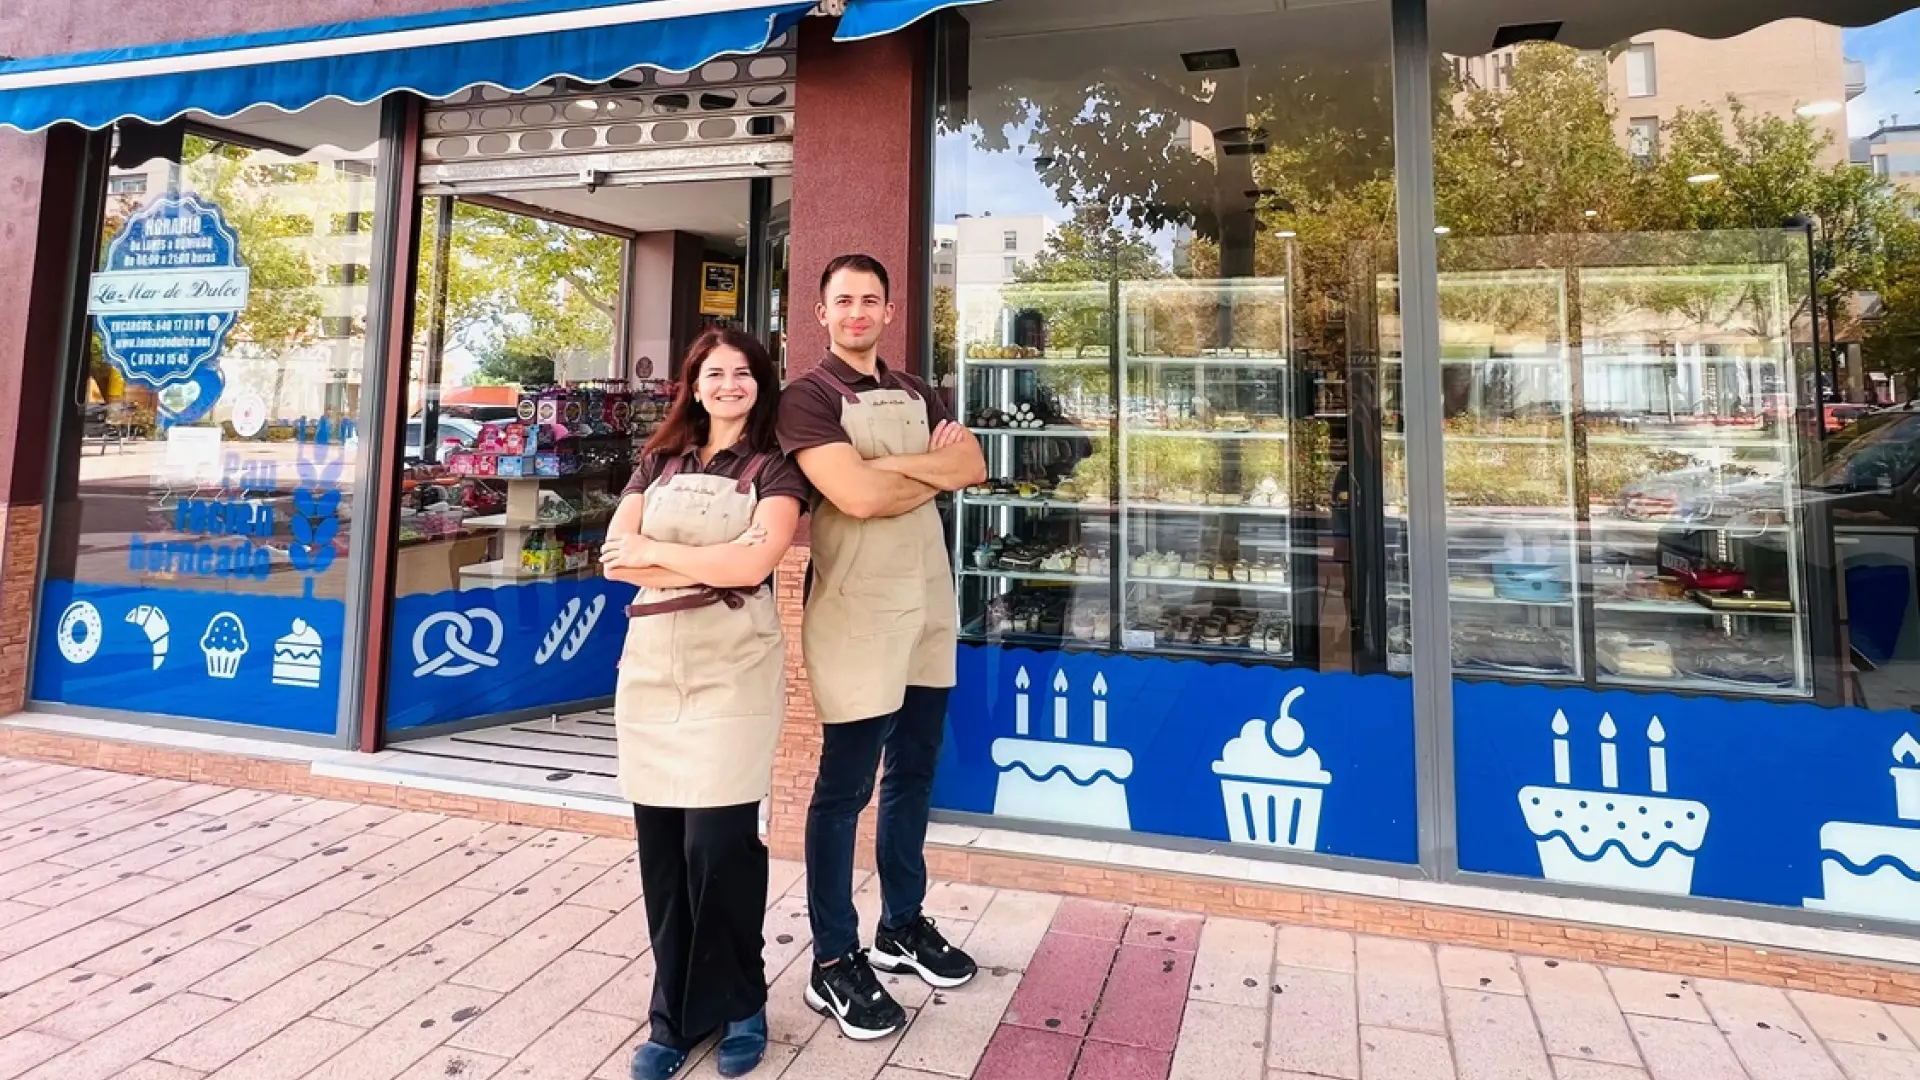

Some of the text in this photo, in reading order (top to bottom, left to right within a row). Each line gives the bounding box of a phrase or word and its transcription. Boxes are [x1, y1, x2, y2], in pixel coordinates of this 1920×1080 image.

[144, 217, 201, 235] HORARIO
[94, 279, 241, 304] La Mar de Dulce
[223, 452, 277, 490] Pan
